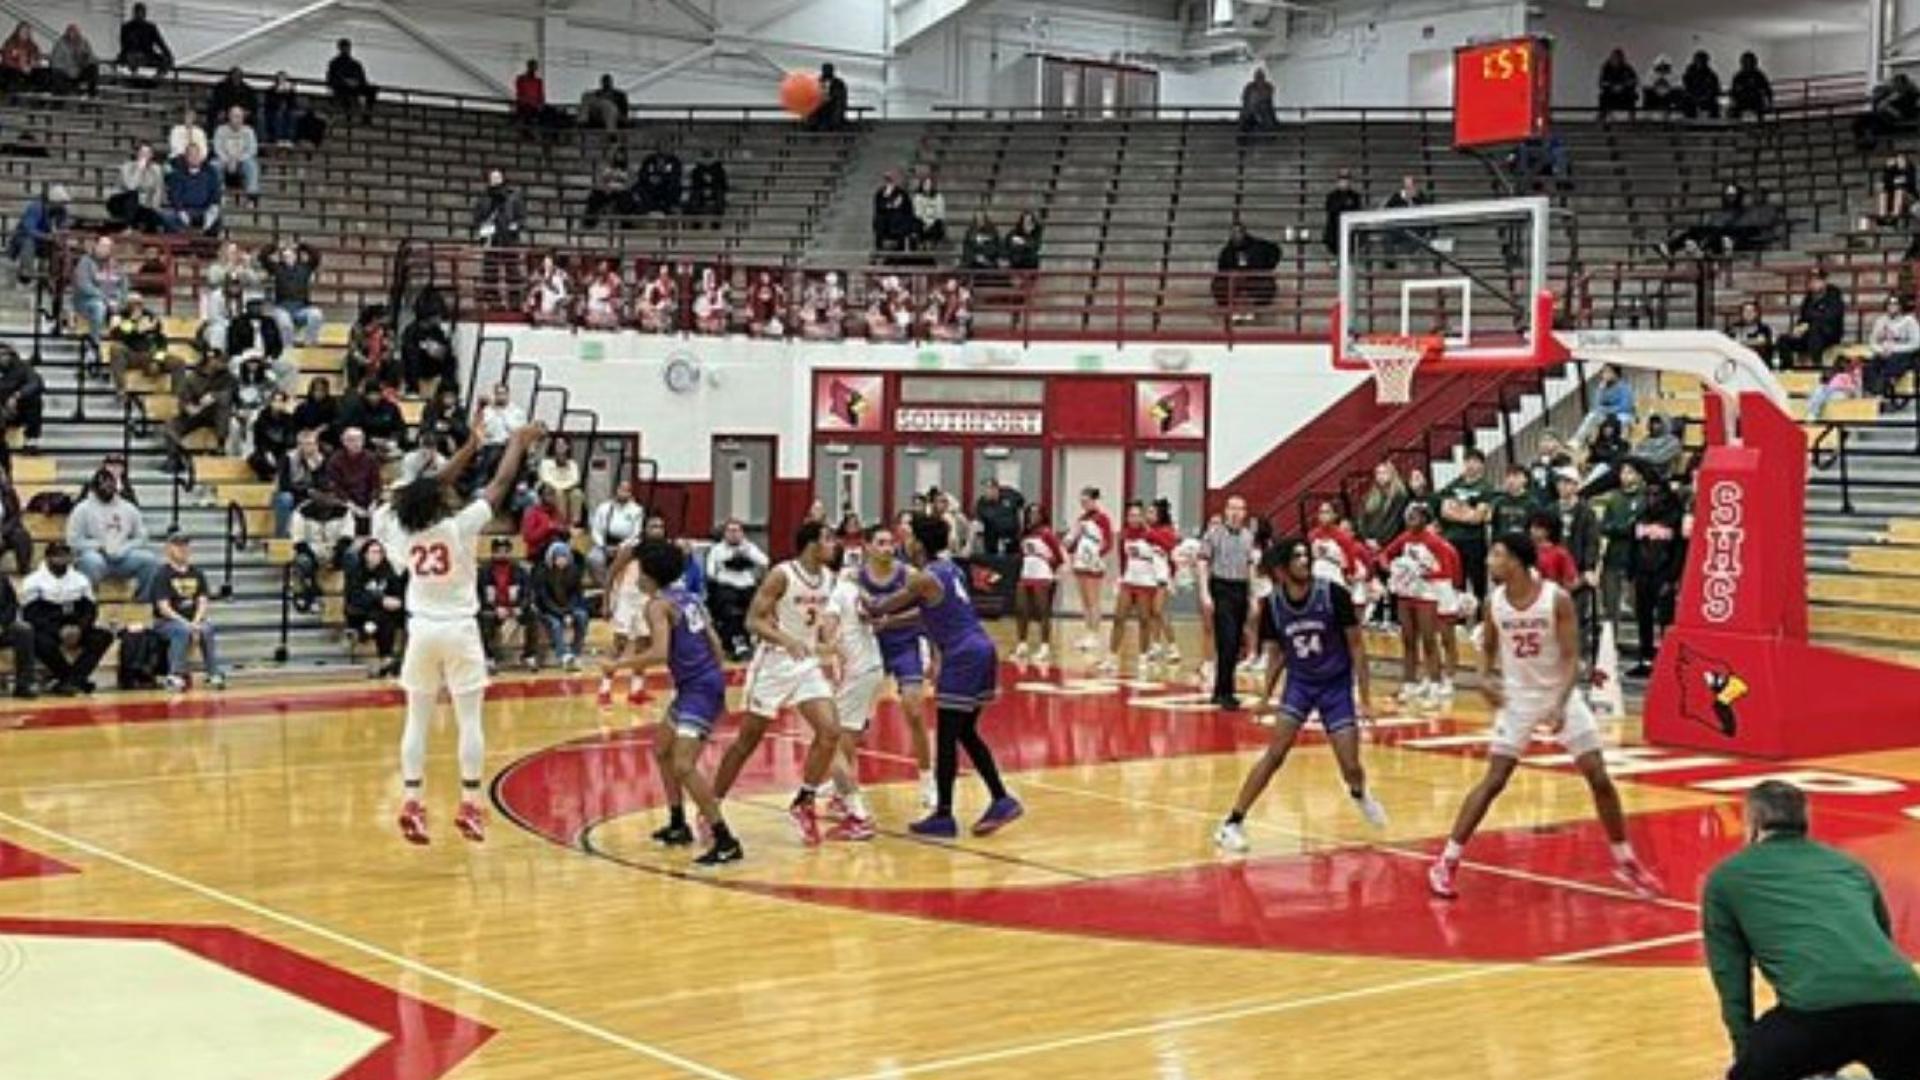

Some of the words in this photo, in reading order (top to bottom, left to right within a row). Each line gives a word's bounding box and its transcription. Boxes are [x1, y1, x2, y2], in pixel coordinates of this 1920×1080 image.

[411, 543, 450, 576] 23
[1703, 481, 1743, 622] SHS
[1293, 632, 1322, 658] 54
[1512, 632, 1541, 658] 25
